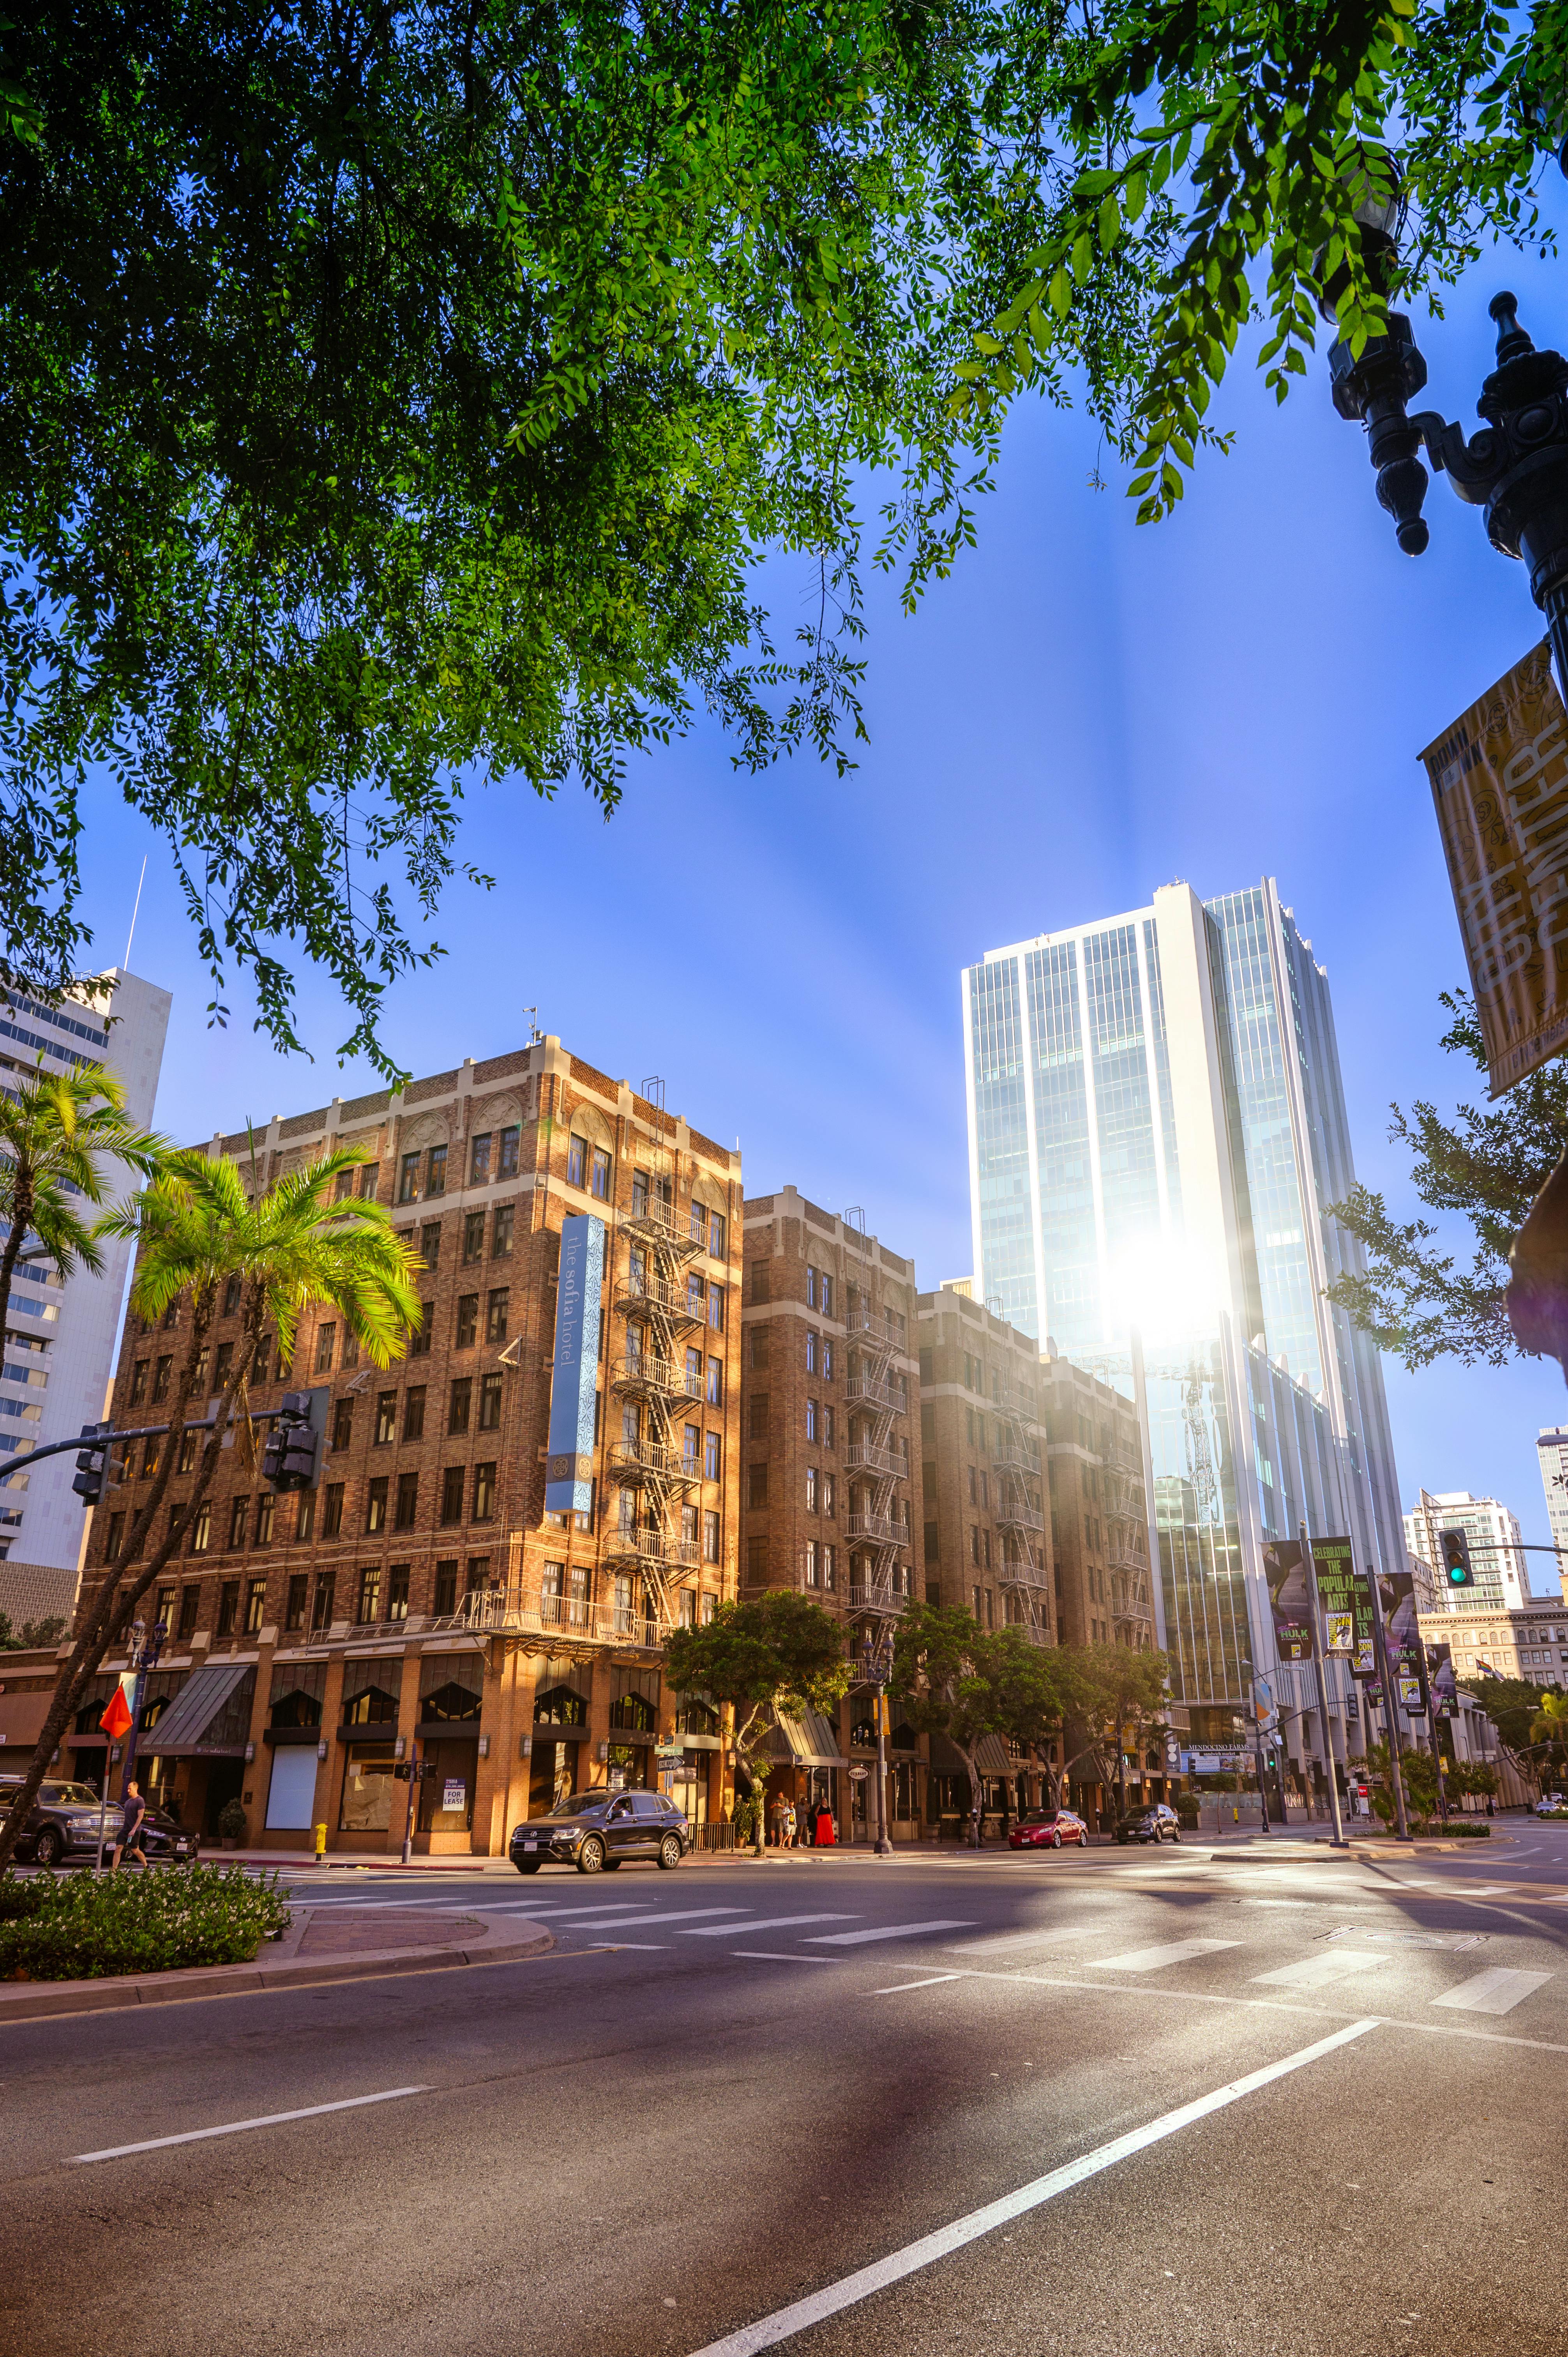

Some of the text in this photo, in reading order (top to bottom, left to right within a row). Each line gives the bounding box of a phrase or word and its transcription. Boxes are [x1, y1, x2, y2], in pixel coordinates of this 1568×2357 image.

[1429, 726, 1469, 777] DOWN
[1460, 860, 1532, 993] CITY
[561, 1235, 582, 1367] the sofia hotel
[1313, 1546, 1351, 1559] CELEBRATING
[1326, 1560, 1342, 1574] THE
[1317, 1575, 1354, 1592] POPULAR
[1328, 1593, 1348, 1610] ARTS
[1337, 1617, 1351, 1626] CON
[1280, 1629, 1308, 1638] HULK
[1328, 1618, 1337, 1644] COMIC
